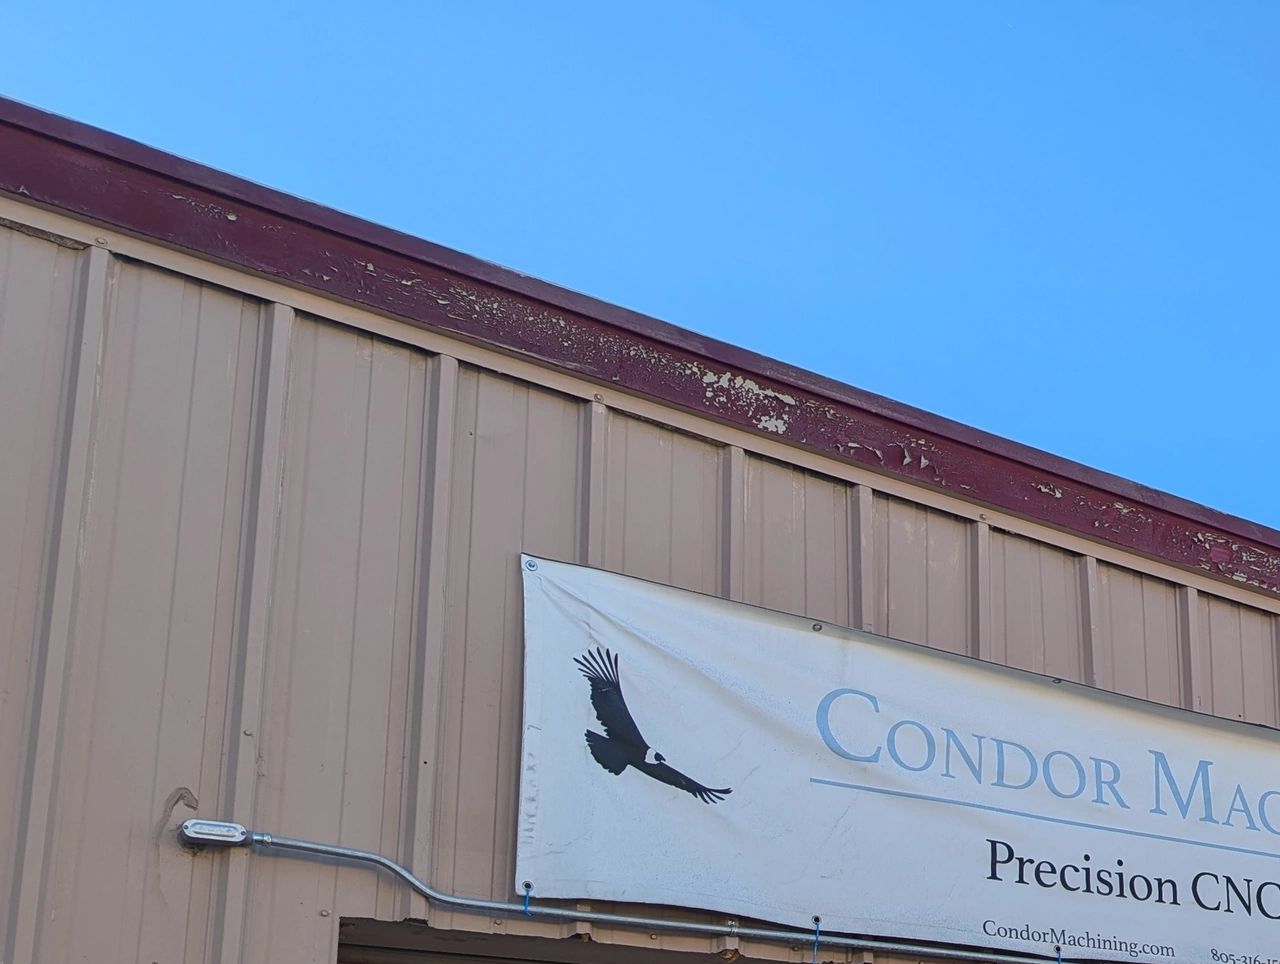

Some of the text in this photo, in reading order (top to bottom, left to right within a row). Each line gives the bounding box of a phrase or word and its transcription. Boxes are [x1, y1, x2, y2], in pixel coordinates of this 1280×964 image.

[815, 687, 1131, 810] CONDOR
[985, 838, 1181, 907] Precision
[982, 919, 1176, 958] CondorMachining.com
